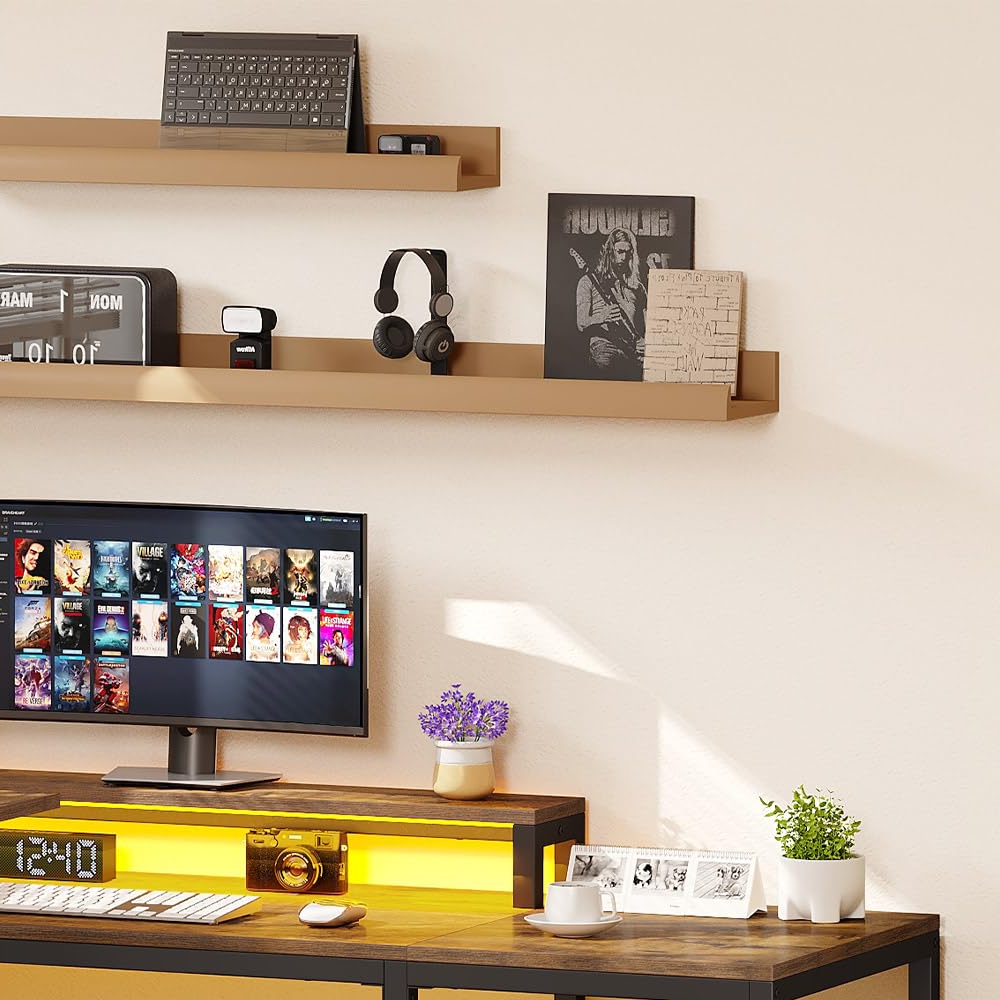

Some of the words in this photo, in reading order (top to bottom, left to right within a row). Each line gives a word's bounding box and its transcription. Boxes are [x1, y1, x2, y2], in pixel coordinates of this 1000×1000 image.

[136, 545, 164, 558] VILLAGE
[62, 602, 83, 610] VILLAGE
[15, 836, 97, 878] 12:40
